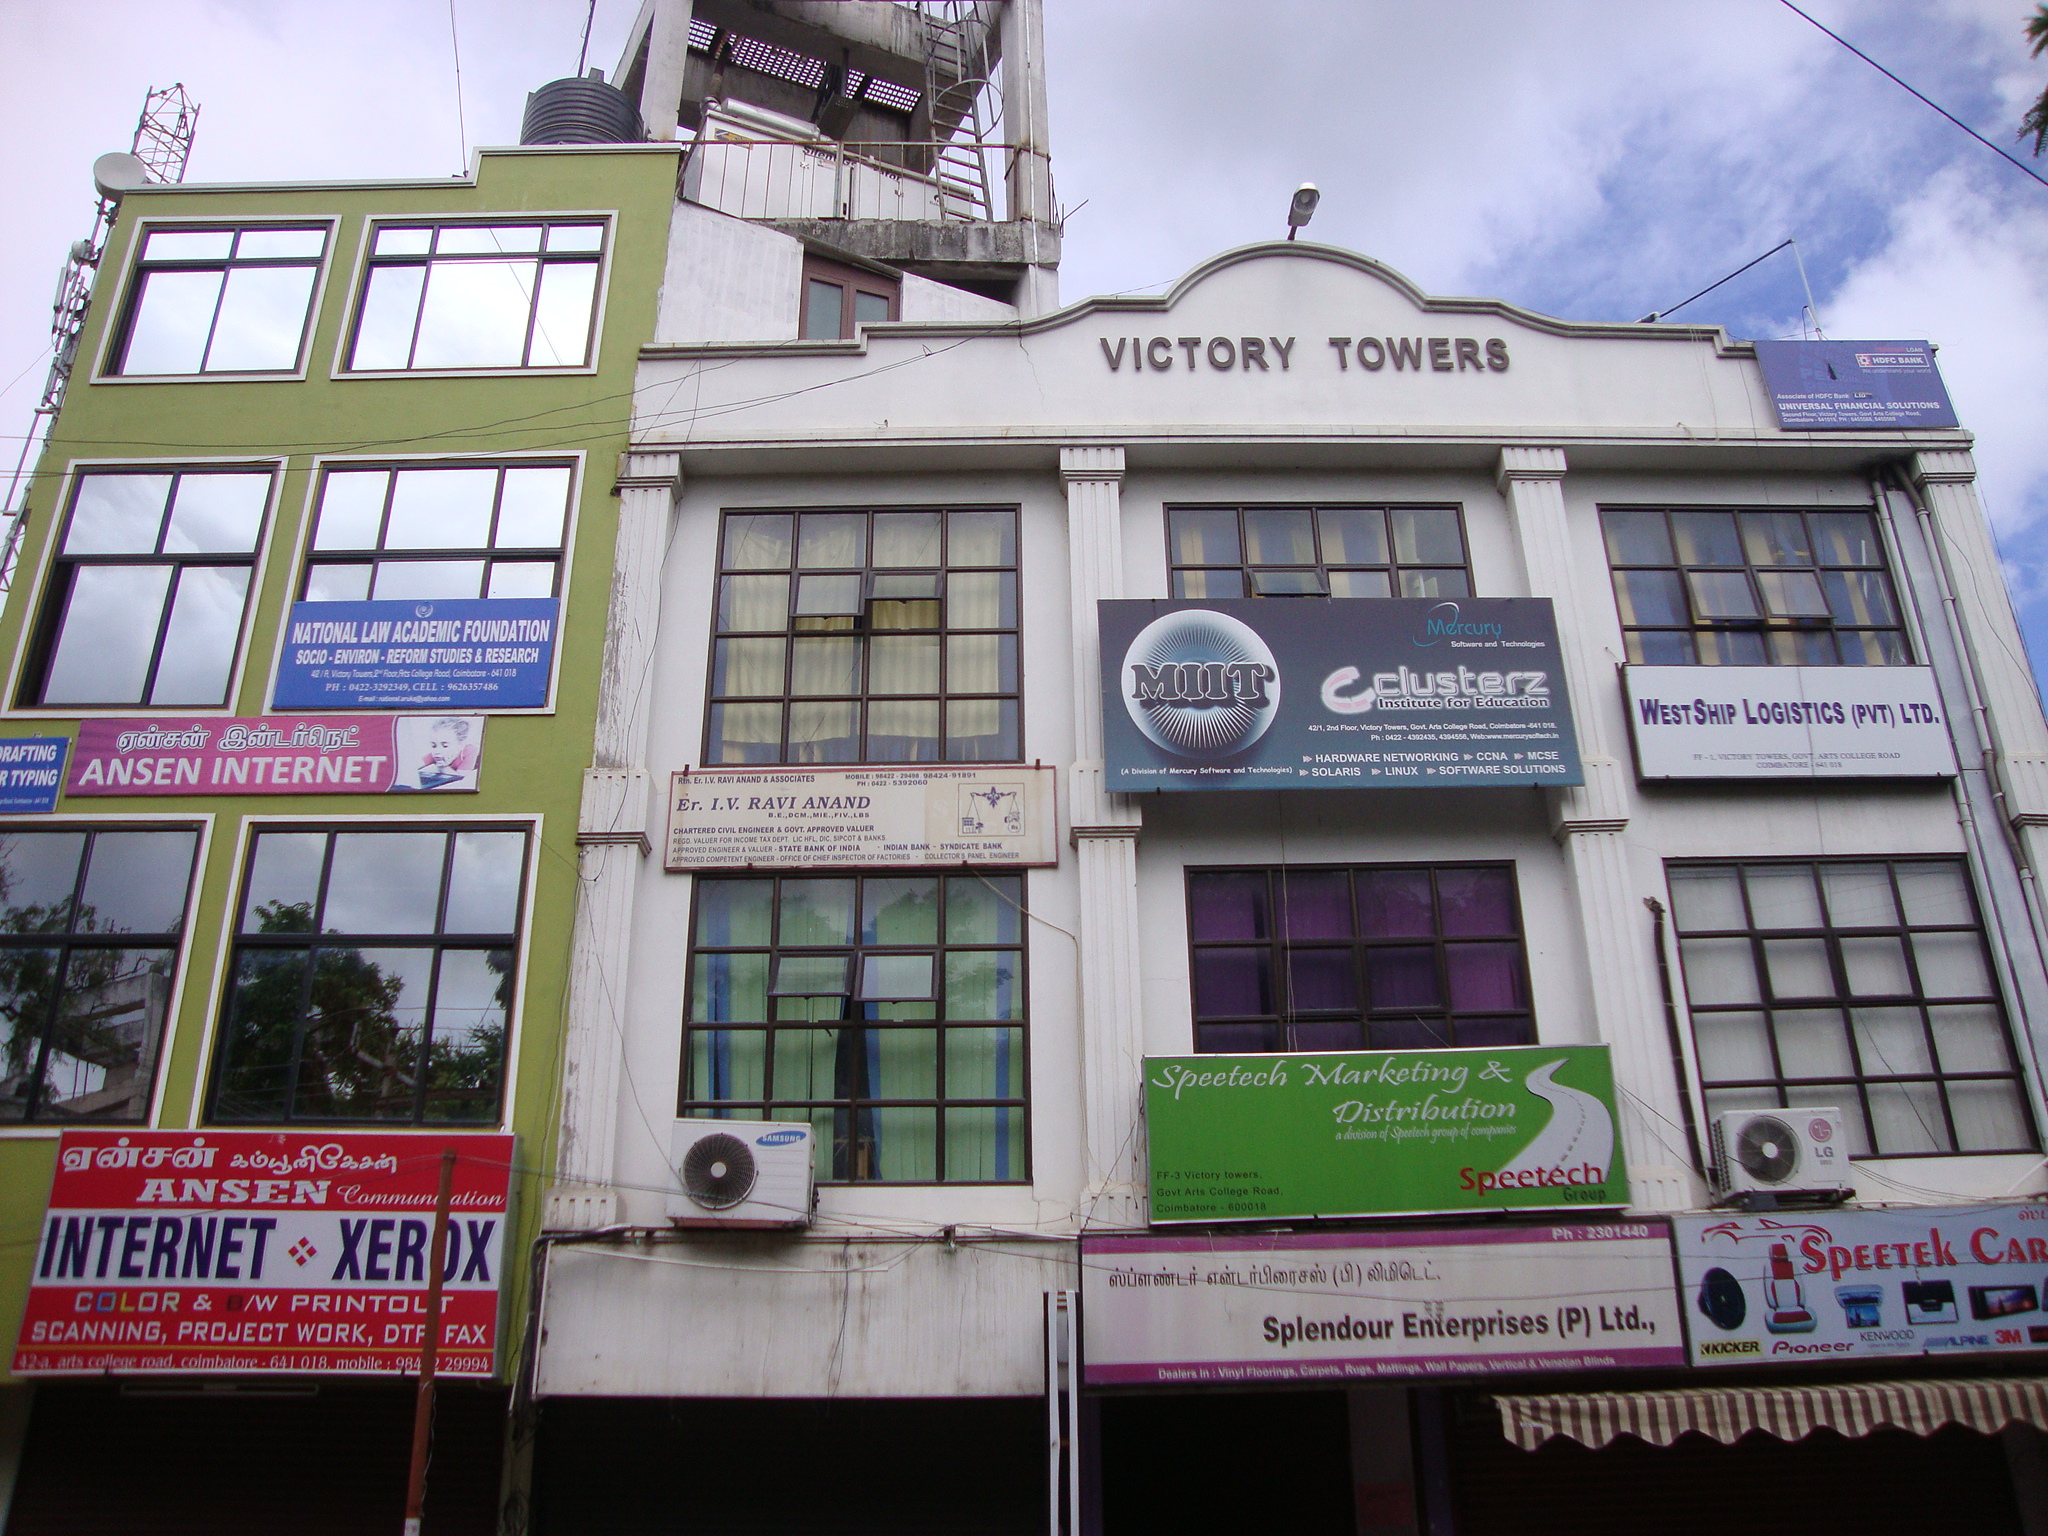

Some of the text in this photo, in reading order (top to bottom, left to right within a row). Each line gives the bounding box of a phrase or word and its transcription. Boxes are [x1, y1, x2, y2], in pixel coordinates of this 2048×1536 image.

[1099, 336, 1511, 372] VICTORY TOWERS
[1778, 402, 1940, 411] UNIVERSAL FINANCIAL SOLUTIONS
[292, 619, 550, 644] NATIONAL LAW ACADEMIC FOUNDATION
[1427, 618, 1502, 639] Mercury
[296, 647, 539, 665] SOCIO ENVIRON REFORM STUDIES & RESEARCH
[325, 683, 340, 692] PH
[412, 682, 438, 691] CELL
[1130, 661, 1268, 701] MIIT
[1378, 696, 1550, 709] Institute for Education
[1851, 703, 1895, 729] (PVT)
[1901, 702, 1940, 724] LTD.
[1340, 724, 1359, 732] Floor,
[1360, 724, 1383, 732] Victory
[1443, 723, 1468, 731] College
[1315, 751, 1559, 763] HARDWARE NETWORKING CCNA MCSE
[11, 769, 58, 786] TYPING
[78, 756, 388, 786] ANSEN INTERNET
[1169, 767, 1197, 776] Mercury
[1248, 766, 1293, 775] Technologies)
[1311, 764, 1566, 777] SOLARIS LINUX SOFTWARE SOLUTIONS
[717, 776, 735, 784] RAVI
[770, 775, 815, 783] ASSOCIATES
[676, 796, 871, 811] Er. I.V. RAVI ANAND
[673, 827, 716, 835] CHARTERED
[738, 826, 775, 834] ENGINEER
[910, 843, 930, 851] BANK
[983, 842, 1003, 850] BANK
[1151, 1056, 1513, 1100] Speetech Marketing &
[1332, 1093, 1516, 1123] Distribution
[762, 1134, 801, 1142] SAMSUNG
[1814, 1146, 1834, 1158] LG
[1156, 1170, 1181, 1180] FF-3
[1184, 1171, 1221, 1181] Victory
[1459, 1162, 1603, 1196] Speetech
[136, 1178, 505, 1207] ANSEN Communiation
[1156, 1188, 1181, 1197] Govt
[1184, 1187, 1206, 1196] Arts
[1209, 1186, 1249, 1197] College
[1563, 1186, 1606, 1202] Group
[1156, 1203, 1267, 1213] Coimbatore 600018
[1551, 1225, 1648, 1241] Ph 2301440
[40, 1216, 278, 1279] INTERNET
[74, 1292, 181, 1312] COLOR
[193, 1294, 212, 1311] &
[31, 1321, 169, 1345] SCANNING,
[178, 1322, 289, 1342] PROJECT
[297, 1323, 374, 1347] WORK,
[444, 1324, 487, 1344] FAX
[1263, 1304, 1656, 1348] Splendour Enterprises (P) Ltd.,
[1772, 1341, 1854, 1354] Pioneer
[1859, 1329, 1915, 1342] KENWOOD
[1994, 1329, 2022, 1344] 3M
[181, 1354, 258, 1369] coimbatore
[269, 1356, 296, 1370] 641
[336, 1356, 382, 1370] mobile
[445, 1356, 489, 1372] 29994
